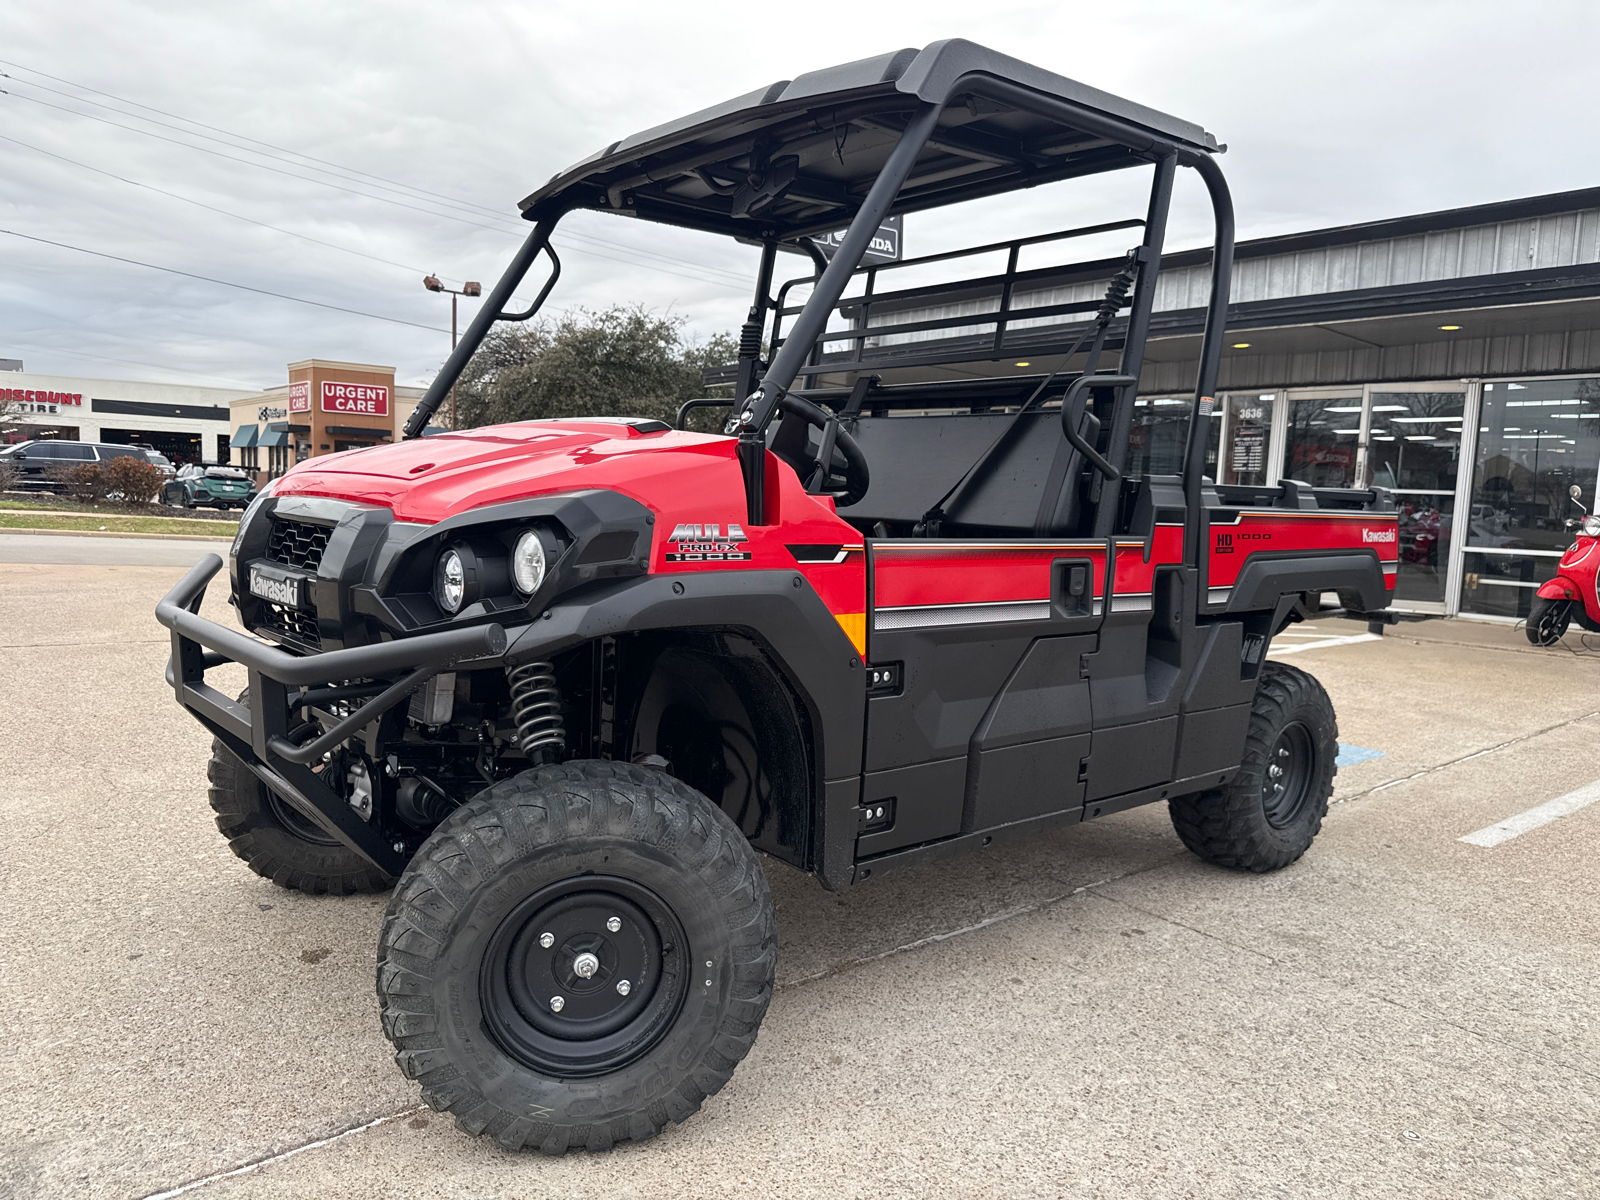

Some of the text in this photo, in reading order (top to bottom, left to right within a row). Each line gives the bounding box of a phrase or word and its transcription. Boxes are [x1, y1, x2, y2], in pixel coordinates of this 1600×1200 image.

[868, 238, 894, 252] NDA
[325, 385, 385, 400] URGENT
[19, 404, 57, 413] TIRE
[292, 398, 306, 409] CARE
[335, 398, 376, 412] CARE
[1239, 409, 1262, 419] 3636
[667, 524, 749, 543] MULE
[1217, 534, 1232, 546] HD
[1362, 528, 1396, 543] Kawasaki
[673, 552, 744, 561] 1000
[250, 569, 298, 606] Kawasaki
[564, 1035, 699, 1118] DURO
